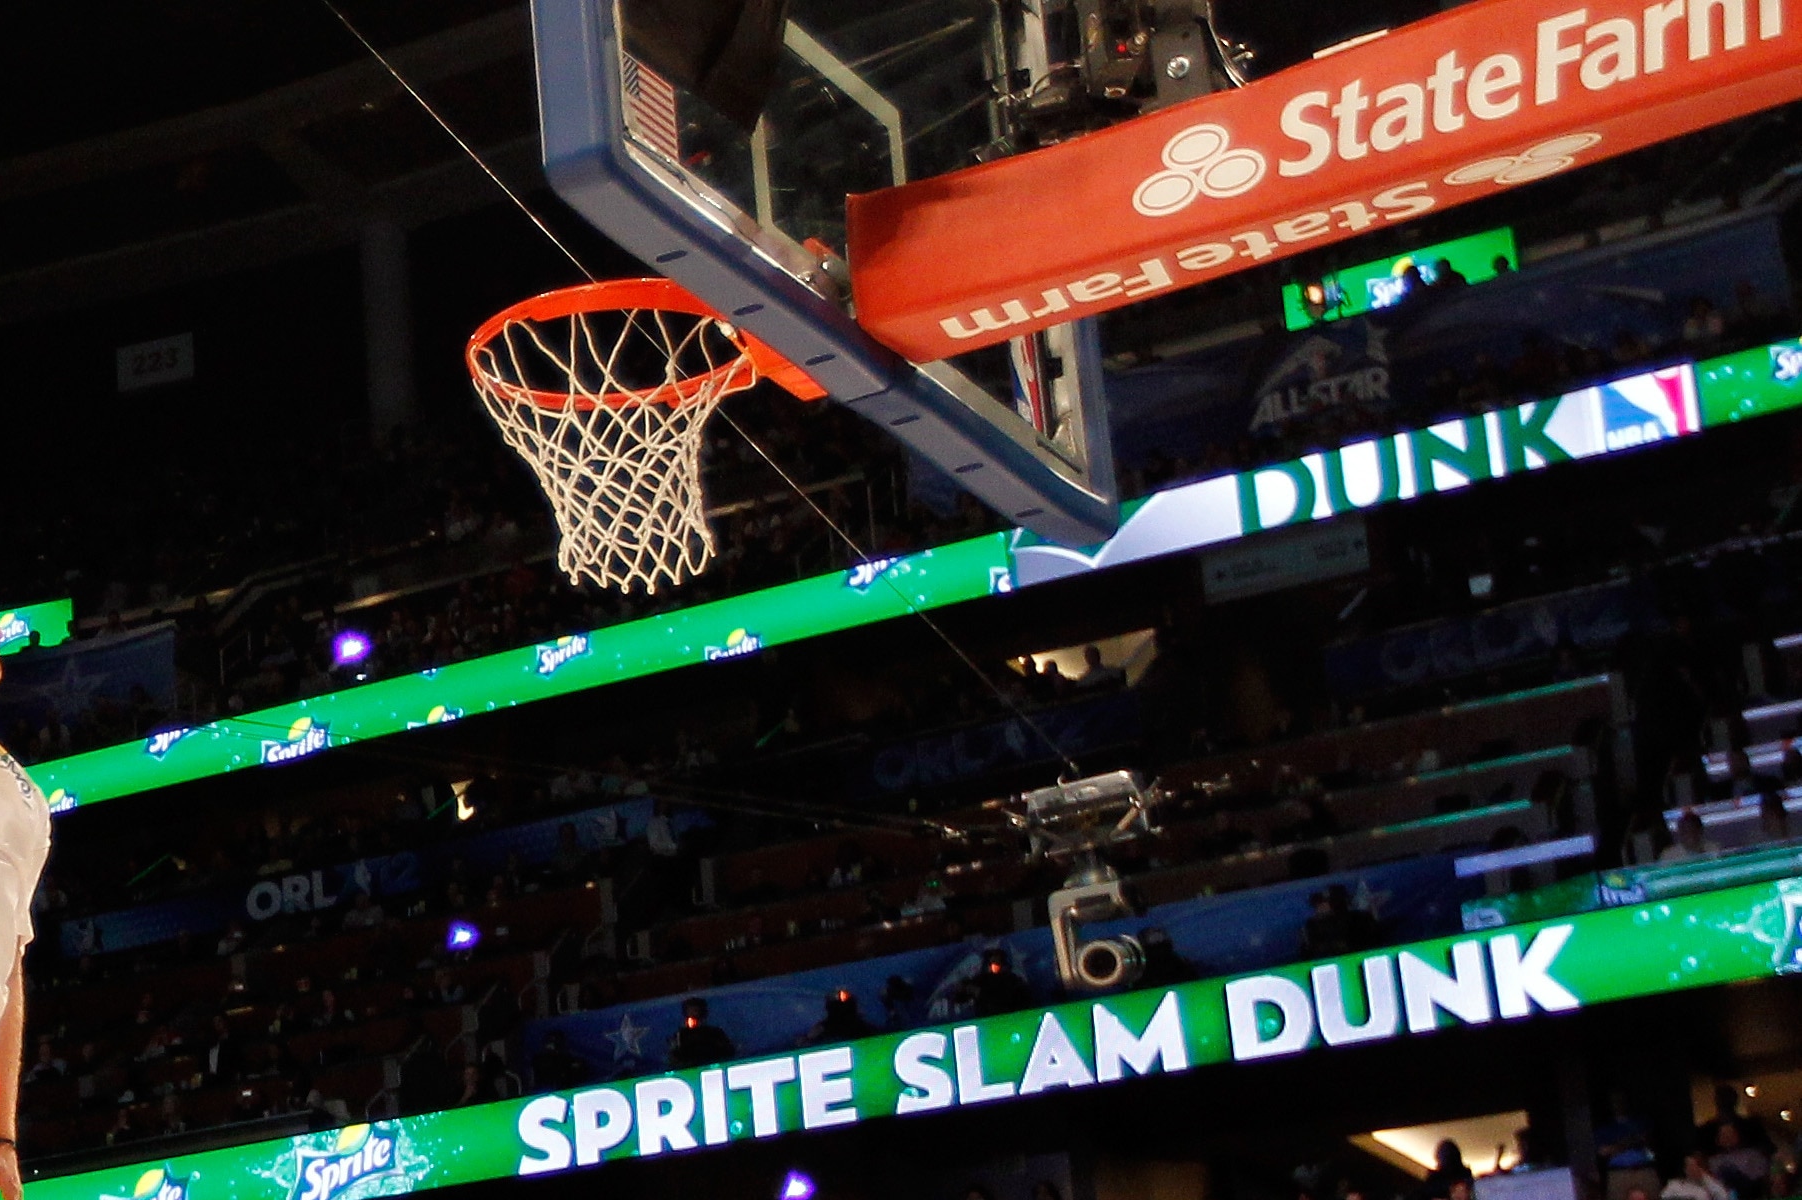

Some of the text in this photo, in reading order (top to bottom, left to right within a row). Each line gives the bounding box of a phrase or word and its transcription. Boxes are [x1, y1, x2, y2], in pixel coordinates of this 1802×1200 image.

[1235, 398, 1575, 536] DUNK
[517, 924, 1581, 1176] SPRITE SLAM DUNK
